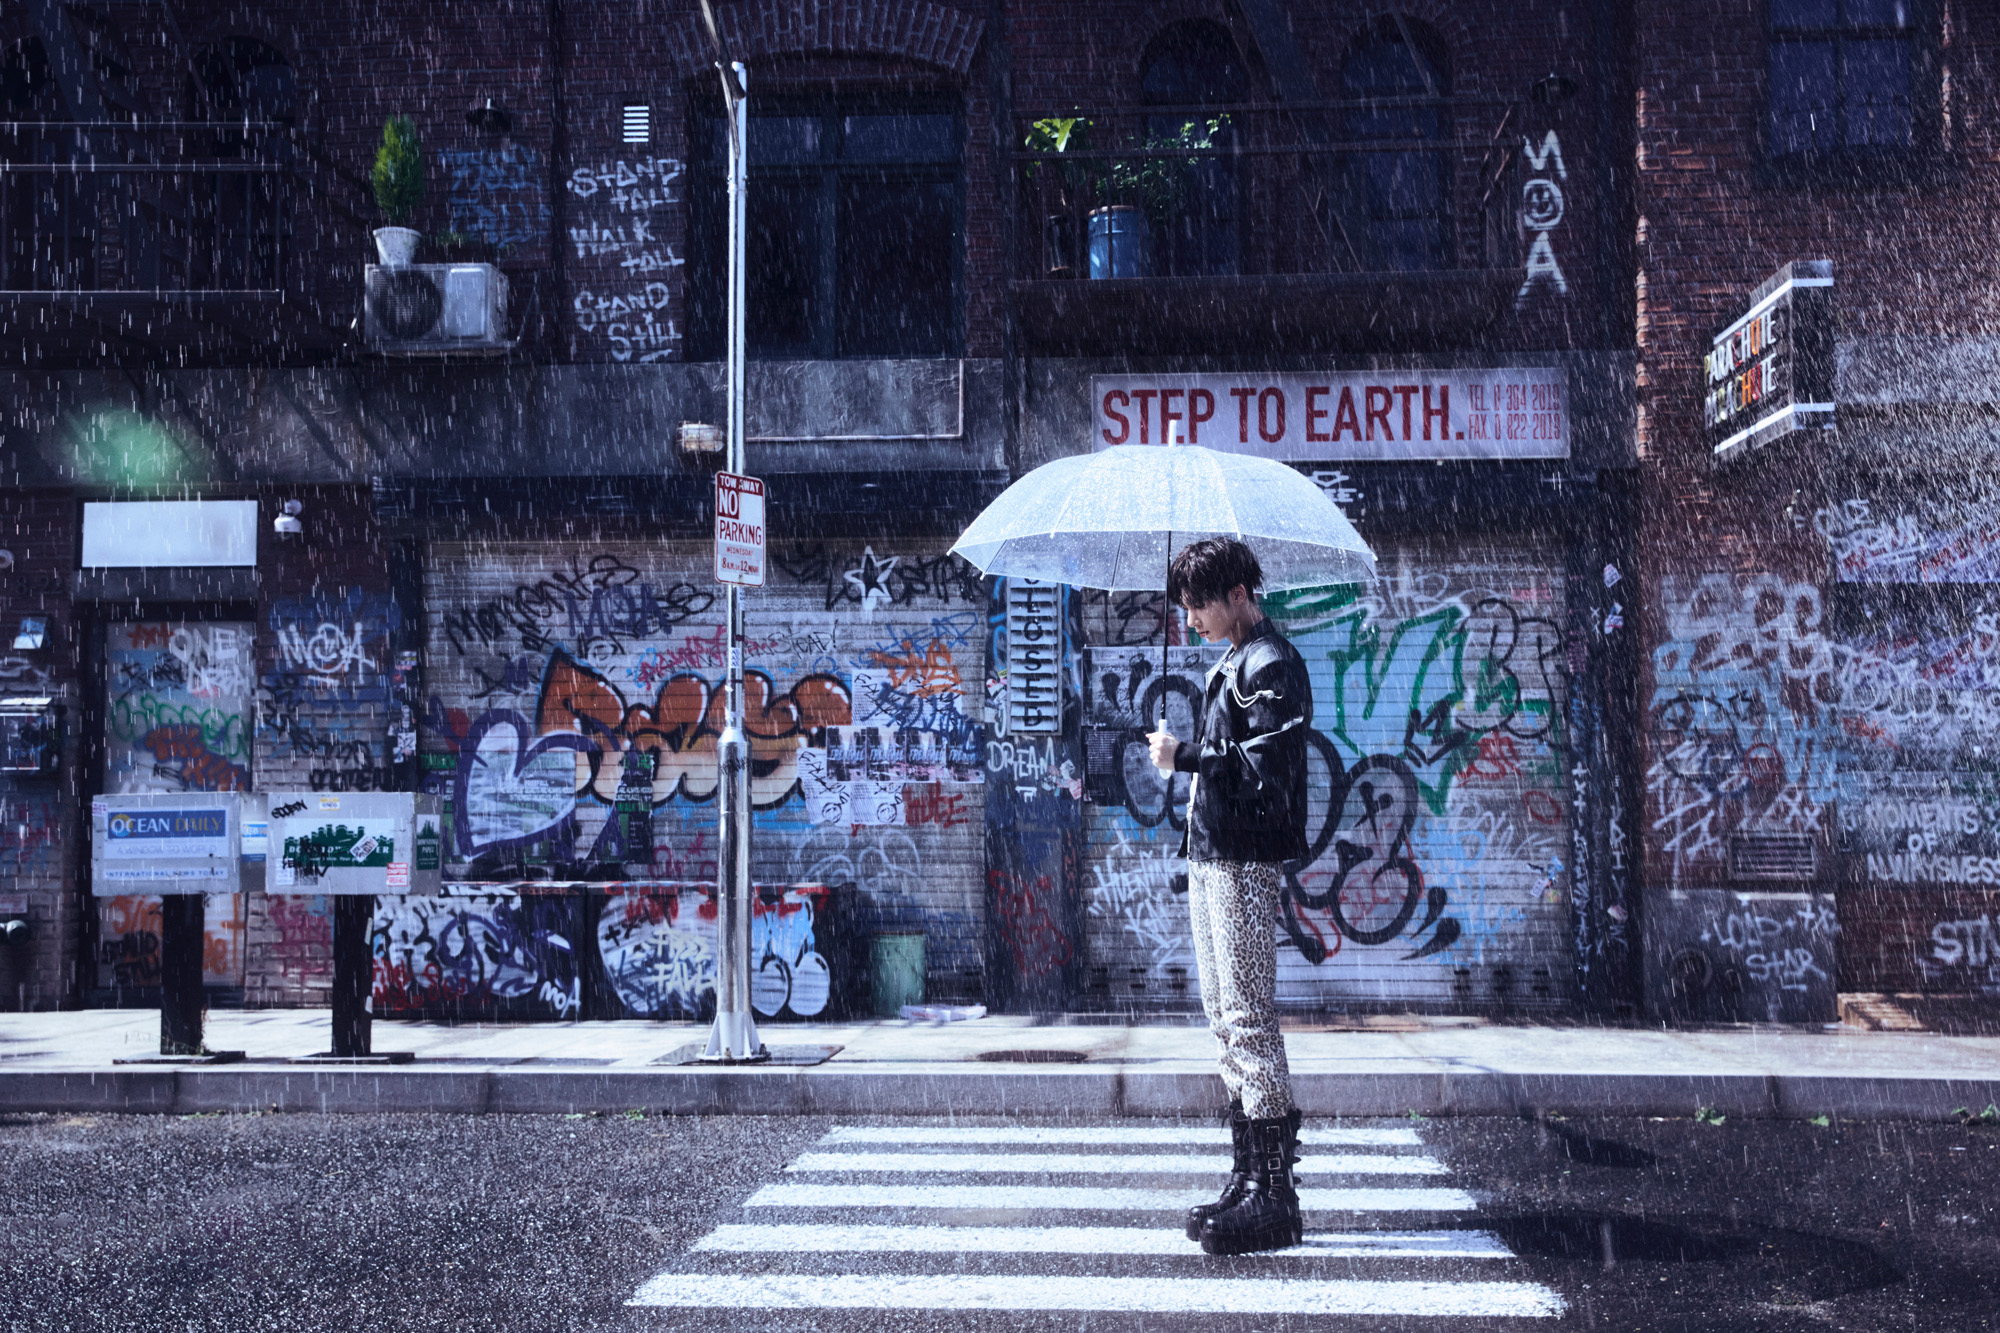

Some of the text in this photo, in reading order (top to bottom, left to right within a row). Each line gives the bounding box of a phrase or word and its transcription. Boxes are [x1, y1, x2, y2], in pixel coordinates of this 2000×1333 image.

[1469, 384, 1490, 411] TEL.
[1102, 384, 1465, 446] STEP TO EARTH.
[1469, 413, 1491, 440] FAX.
[719, 474, 737, 488] TOW
[719, 487, 738, 516] NO
[719, 519, 762, 546] PARKING
[722, 557, 728, 569] 8
[740, 560, 748, 571] 12
[169, 626, 239, 664] ONE
[986, 736, 1057, 781] DREAM
[110, 816, 222, 833] OCEAN DAILY
[1907, 831, 1939, 854] OF
